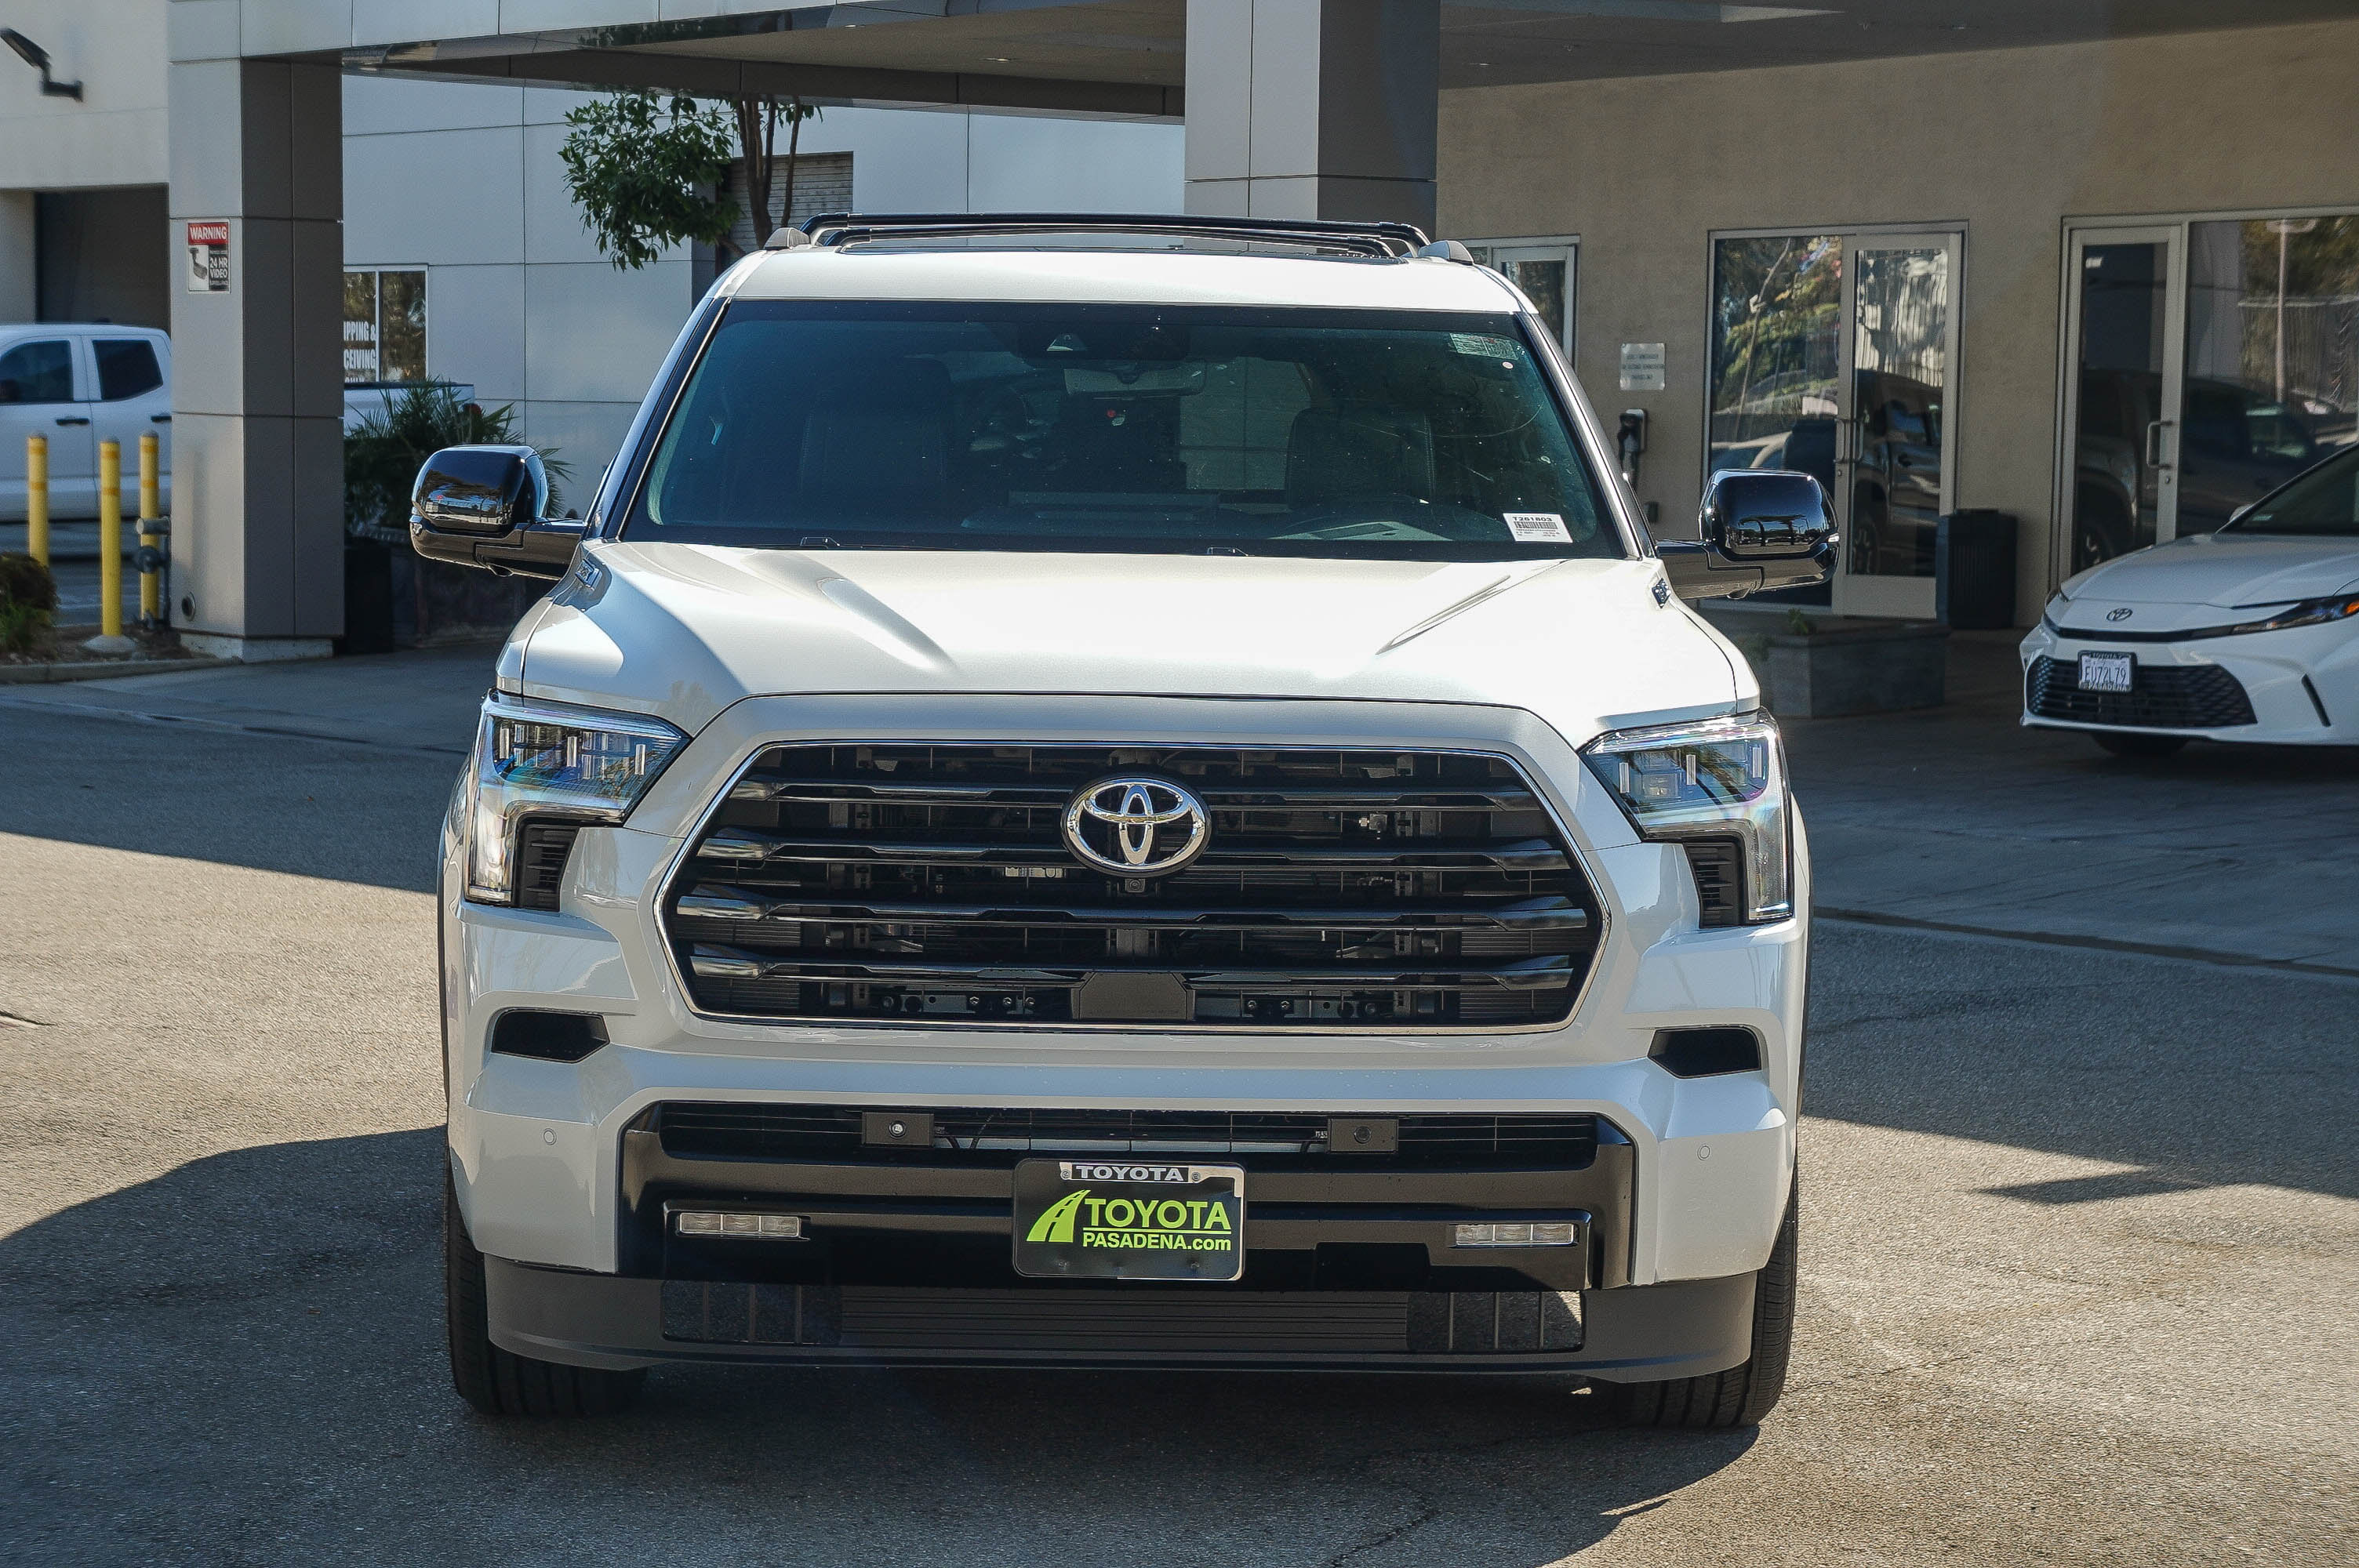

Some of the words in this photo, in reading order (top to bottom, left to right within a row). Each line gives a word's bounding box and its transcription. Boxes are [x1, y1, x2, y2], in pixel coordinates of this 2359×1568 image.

[190, 227, 227, 240] WARNING
[209, 257, 218, 268] 24
[219, 257, 228, 268] HR
[209, 269, 228, 278] VIDEO
[1076, 1166, 1183, 1181] TOYOTA
[1085, 1198, 1231, 1230] TOYOTA
[1082, 1232, 1231, 1251] PASADENA.com
